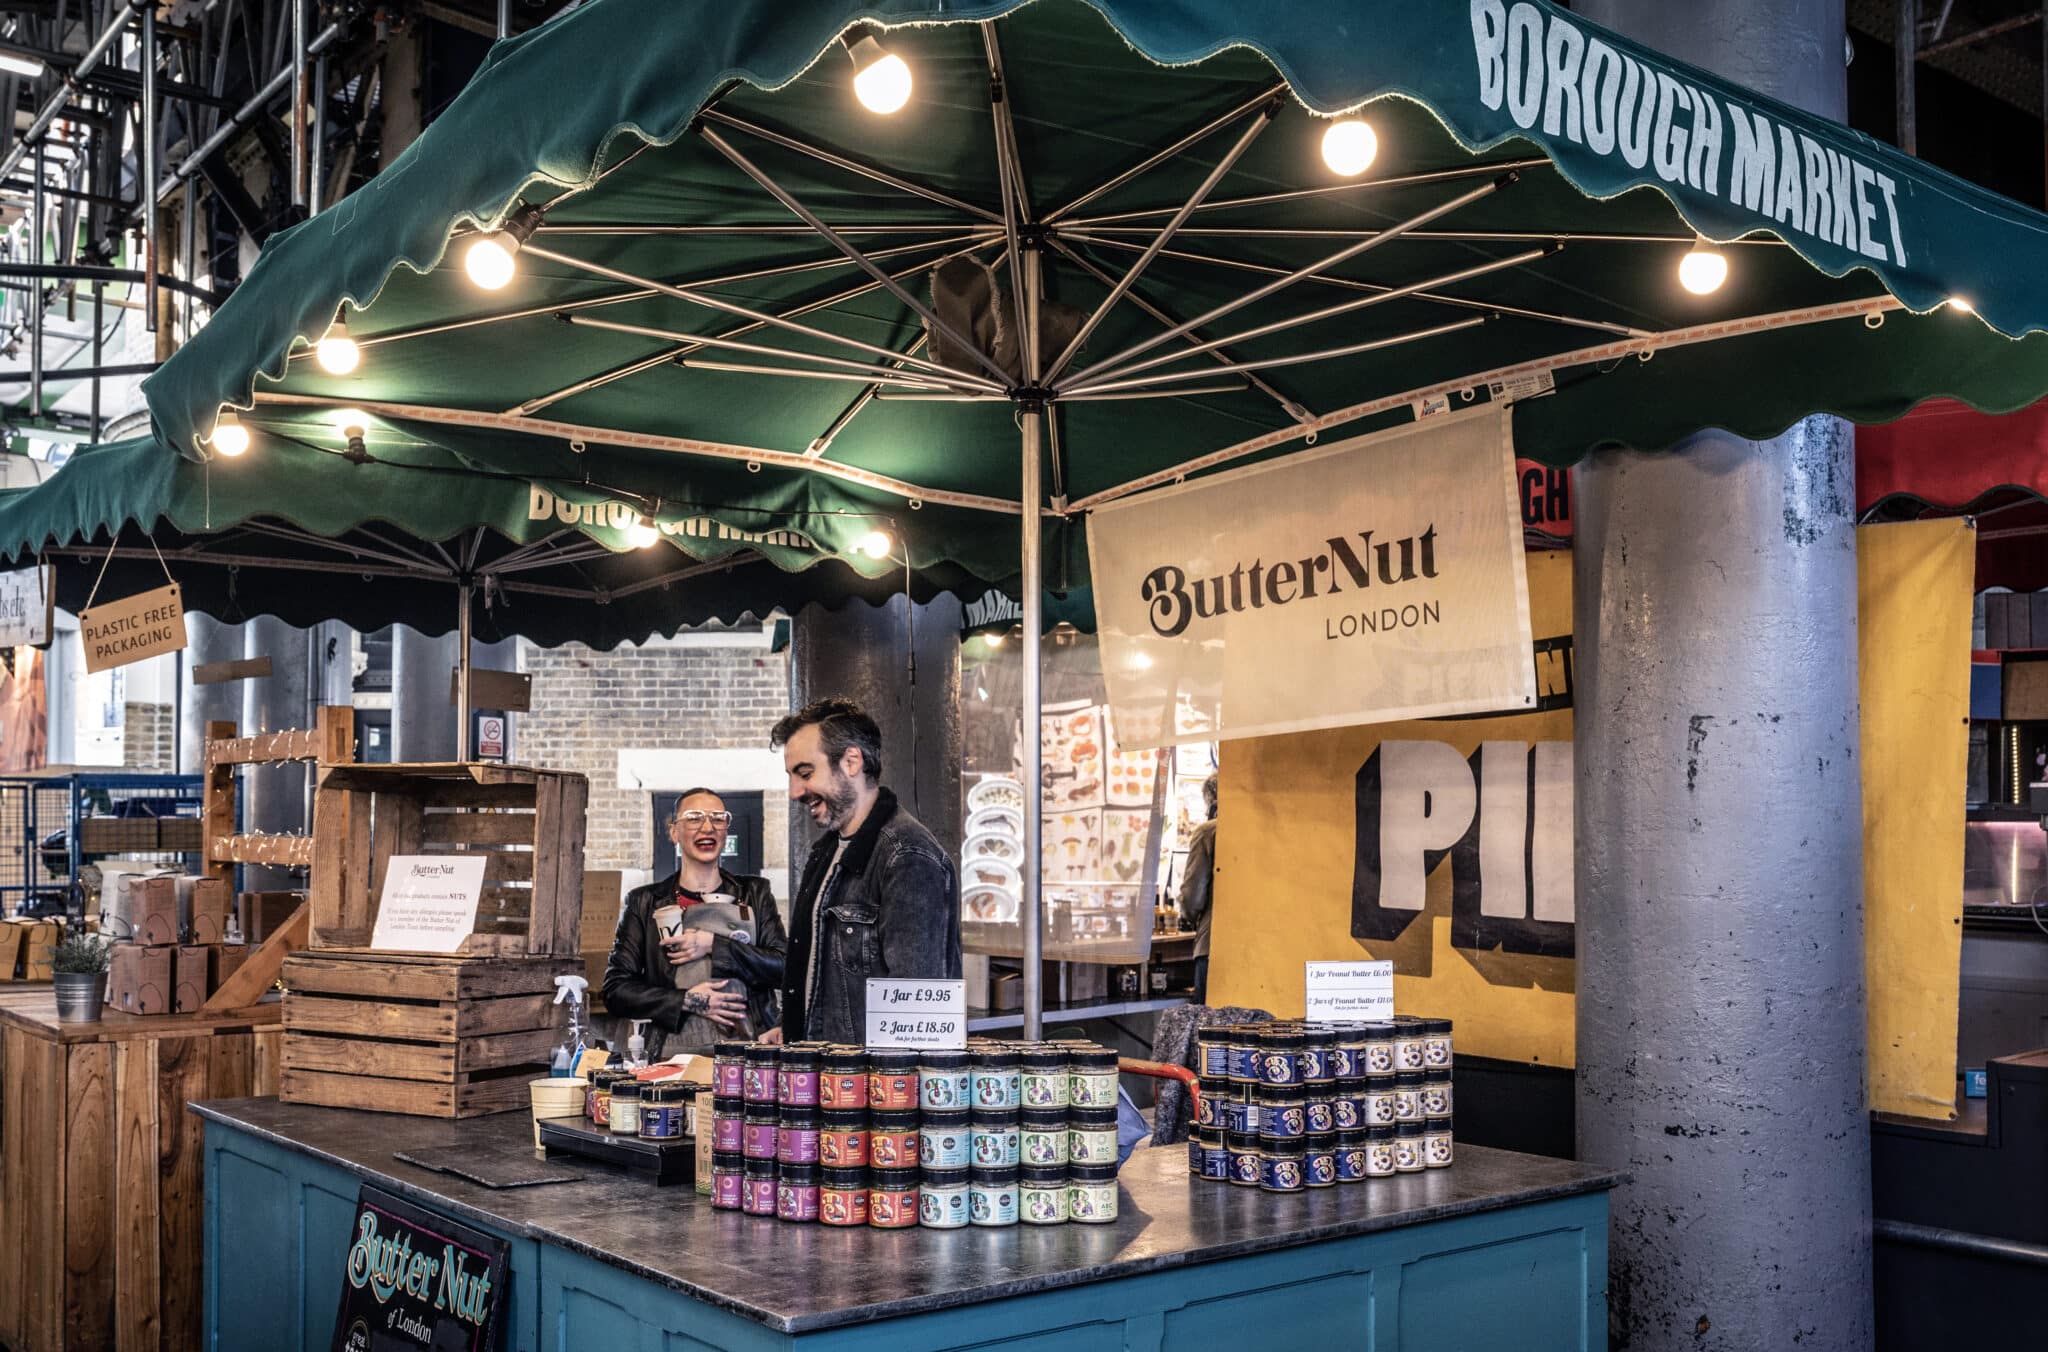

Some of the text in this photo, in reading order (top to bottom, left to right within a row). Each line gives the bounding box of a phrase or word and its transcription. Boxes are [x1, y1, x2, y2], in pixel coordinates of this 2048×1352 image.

[1469, 0, 1908, 268] BOROUGH MARKET
[1518, 467, 1569, 525] GH
[1141, 523, 1440, 638] ButterNut
[86, 604, 177, 642] PLASTIC FREE
[1326, 600, 1441, 640] LONDON
[96, 626, 173, 659] PACKAGING
[882, 988, 951, 1004] 1 Jar £9.95
[1334, 997, 1356, 1005] Peanut
[879, 1020, 955, 1035] 2 Jars £18.50
[347, 1210, 492, 1327] Butter Nut
[387, 1308, 432, 1344] of London
